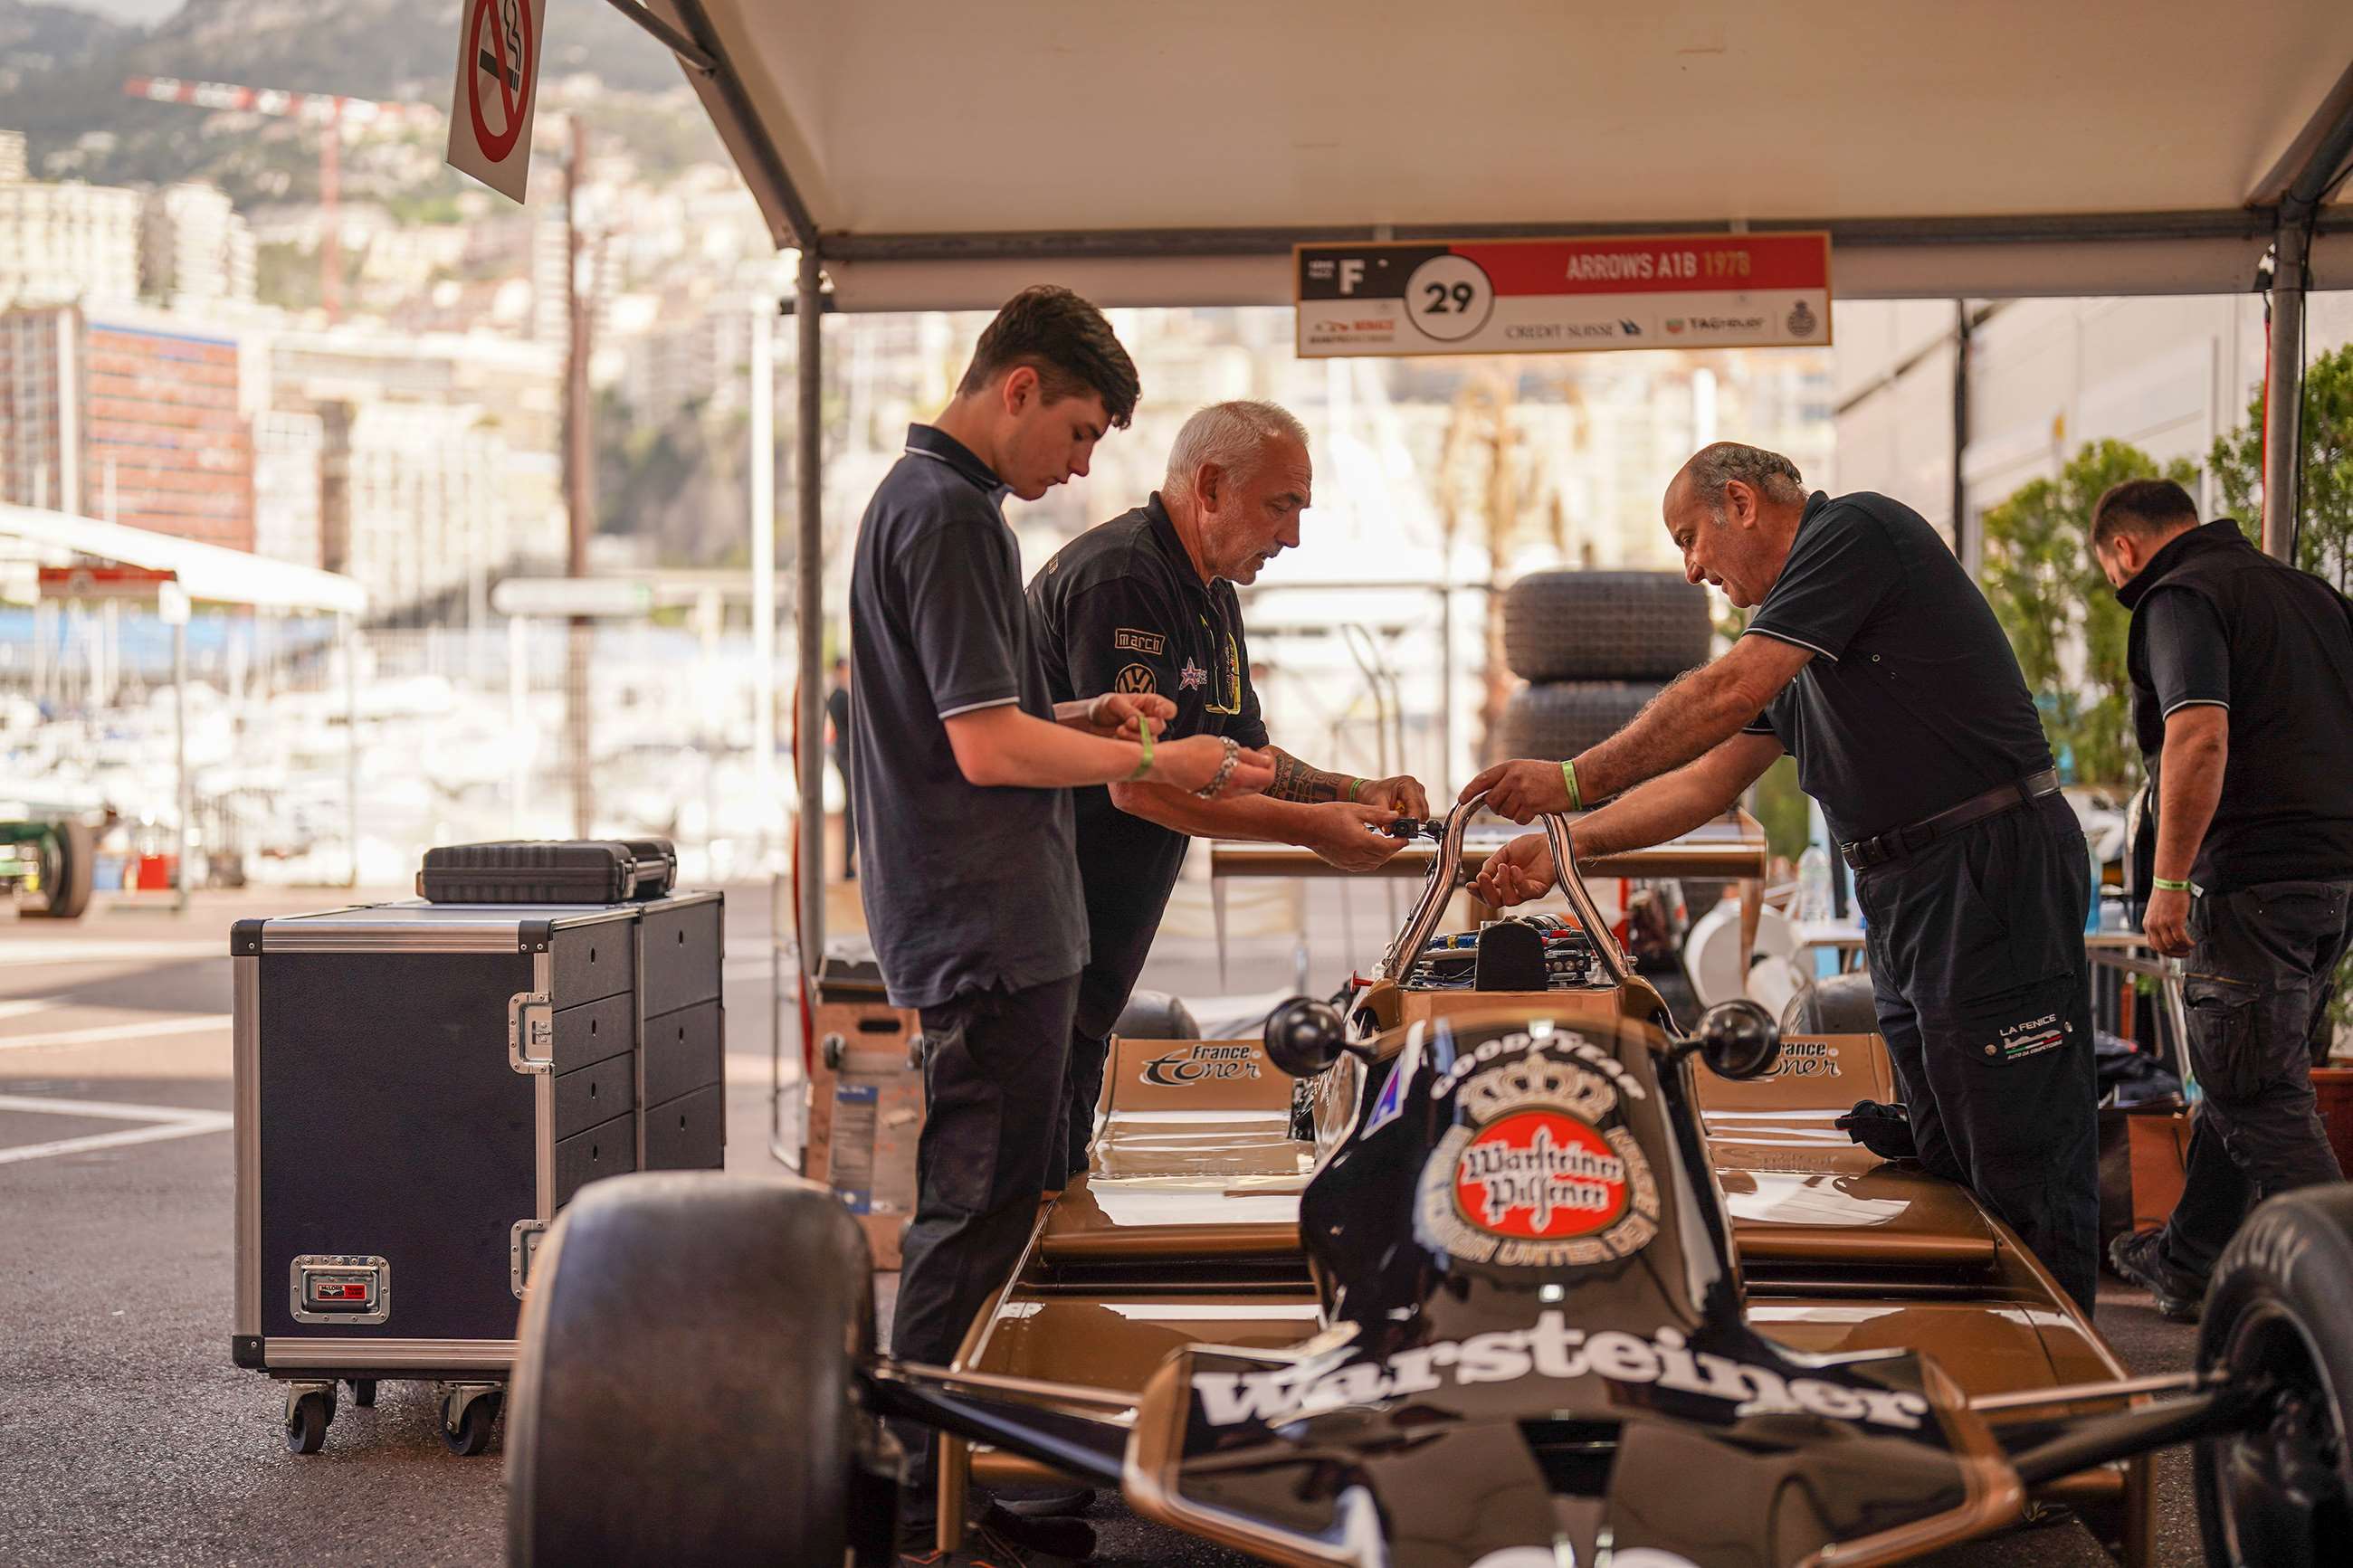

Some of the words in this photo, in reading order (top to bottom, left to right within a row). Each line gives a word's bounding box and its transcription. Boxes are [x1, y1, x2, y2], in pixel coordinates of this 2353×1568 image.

[1339, 259, 1365, 295] F
[1566, 253, 1653, 280] ARROWS
[1658, 252, 1697, 279] A1B
[1424, 281, 1475, 314] 29
[1119, 633, 1160, 652] march
[1999, 1026, 2018, 1036] LA
[2018, 1013, 2057, 1031] FENICE
[1191, 1044, 1251, 1060] France
[1778, 1042, 1827, 1057] rance
[1138, 1049, 1262, 1086] toner
